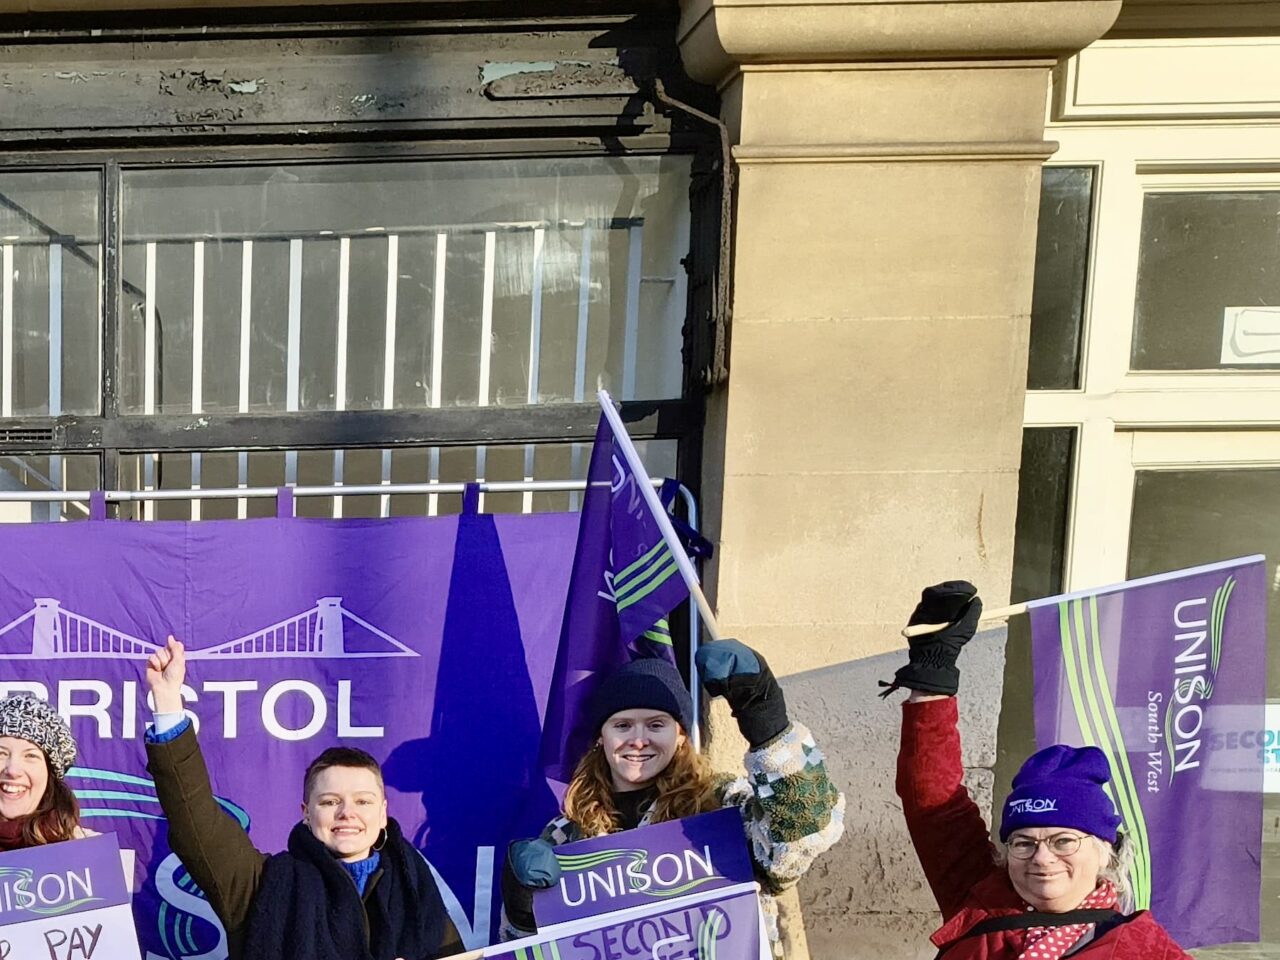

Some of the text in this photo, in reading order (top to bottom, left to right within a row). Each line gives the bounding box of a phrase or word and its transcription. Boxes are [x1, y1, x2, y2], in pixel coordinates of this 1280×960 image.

[1173, 598, 1207, 772] UNISON
[1147, 691, 1162, 793] South West
[560, 845, 714, 907] UNISON
